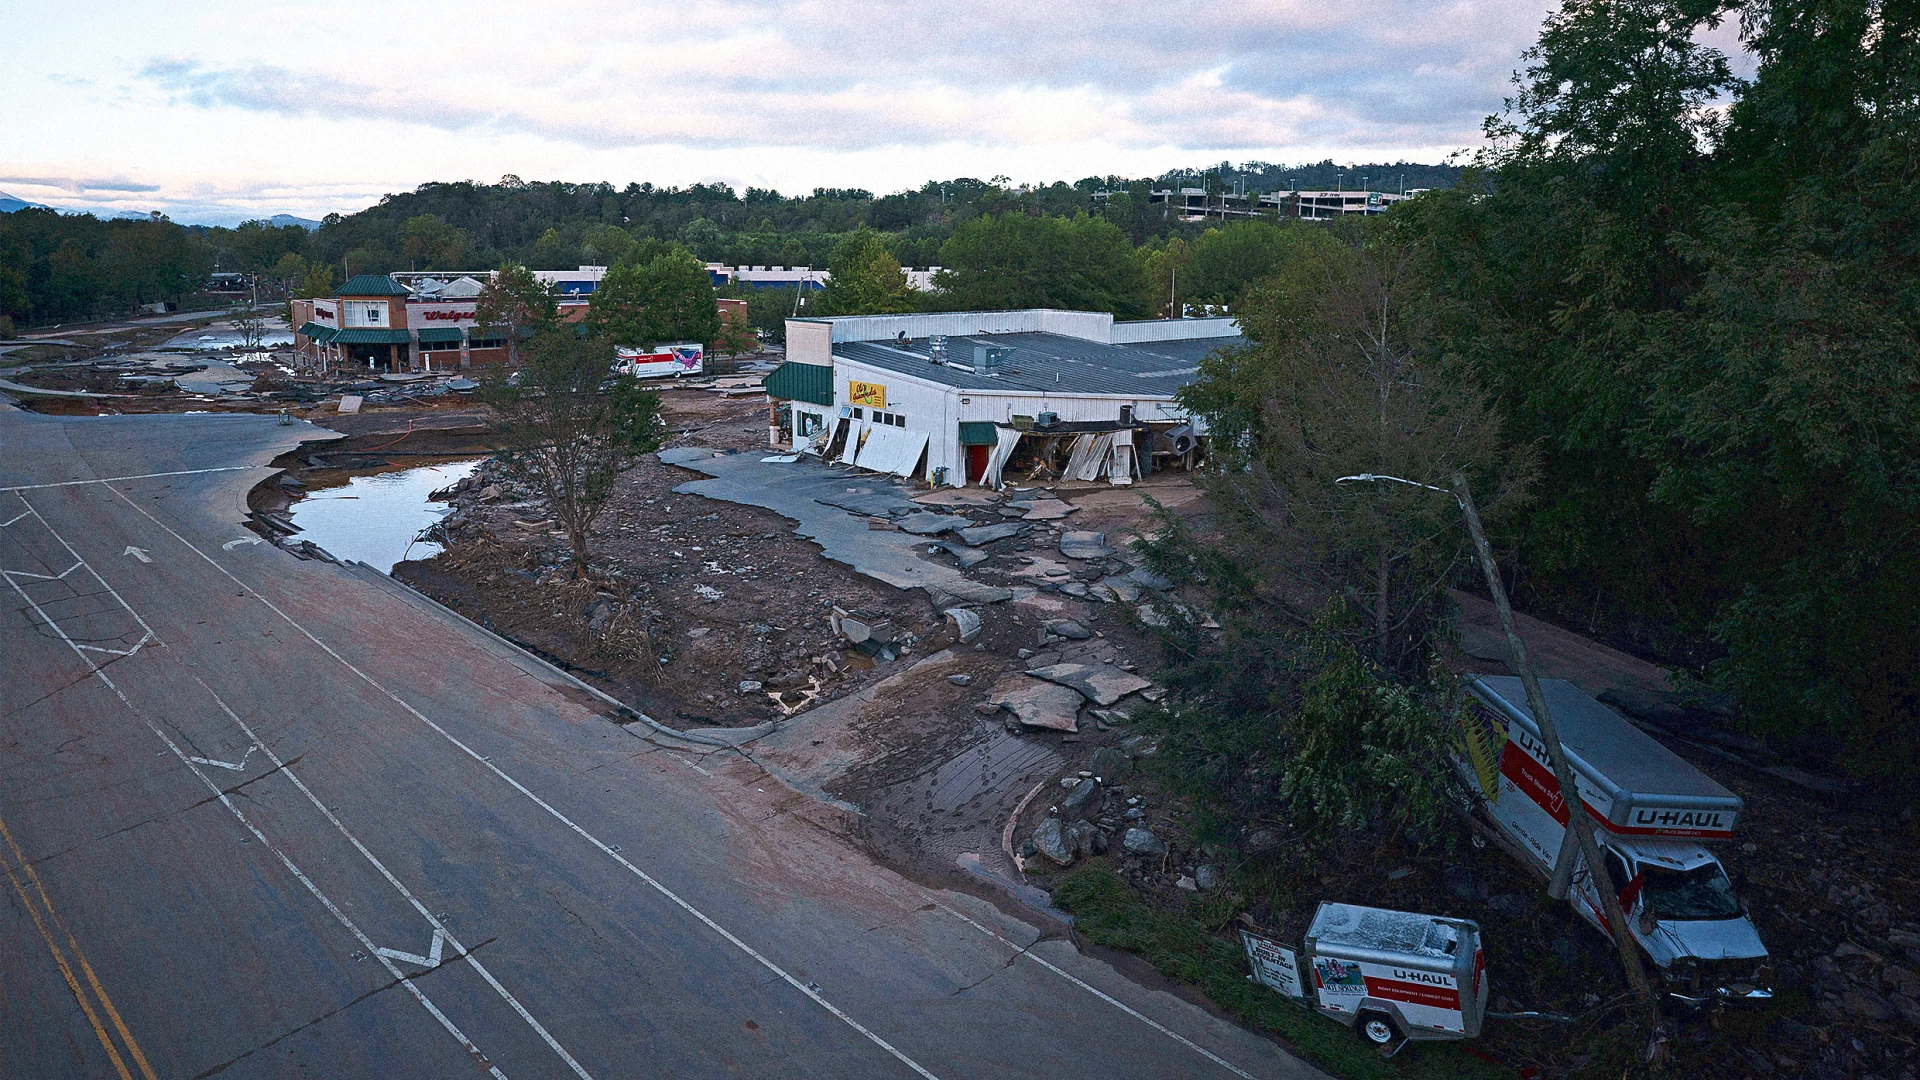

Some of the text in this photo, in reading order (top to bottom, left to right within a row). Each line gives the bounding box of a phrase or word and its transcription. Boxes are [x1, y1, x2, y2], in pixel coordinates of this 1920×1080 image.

[423, 310, 476, 322] Walgre
[1636, 810, 1724, 827] U-HAUL
[1255, 947, 1287, 962] BUILT-IN
[1394, 969, 1453, 986] U-HAUL
